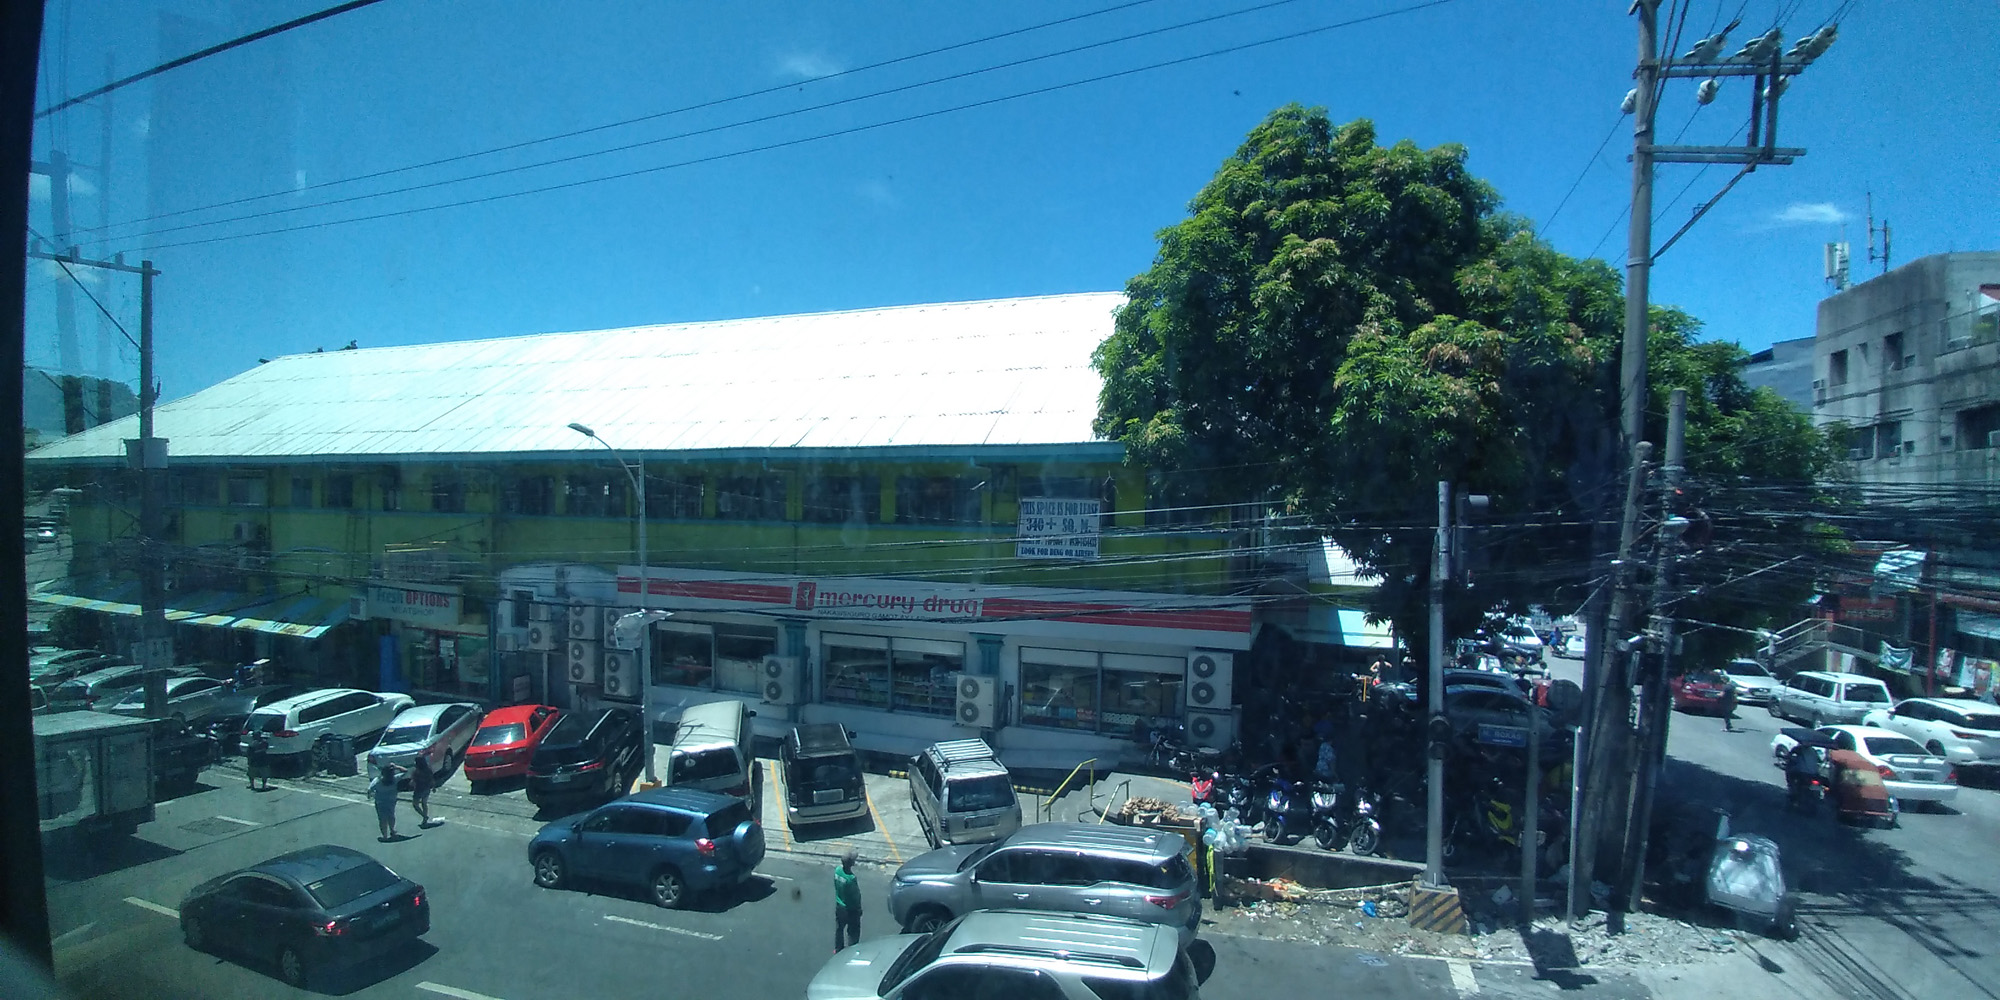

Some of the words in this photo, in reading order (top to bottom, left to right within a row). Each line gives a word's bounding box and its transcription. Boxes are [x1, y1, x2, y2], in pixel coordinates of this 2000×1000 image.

[1021, 501, 1035, 515] THIS
[1036, 501, 1056, 516] SPACE
[1057, 502, 1064, 516] IS
[1065, 502, 1078, 516] FOR
[1021, 547, 1036, 555] LOOK
[1037, 548, 1049, 556] FOR
[405, 590, 450, 608] OPTIONS
[819, 591, 915, 614] mercury
[922, 594, 978, 617] drug
